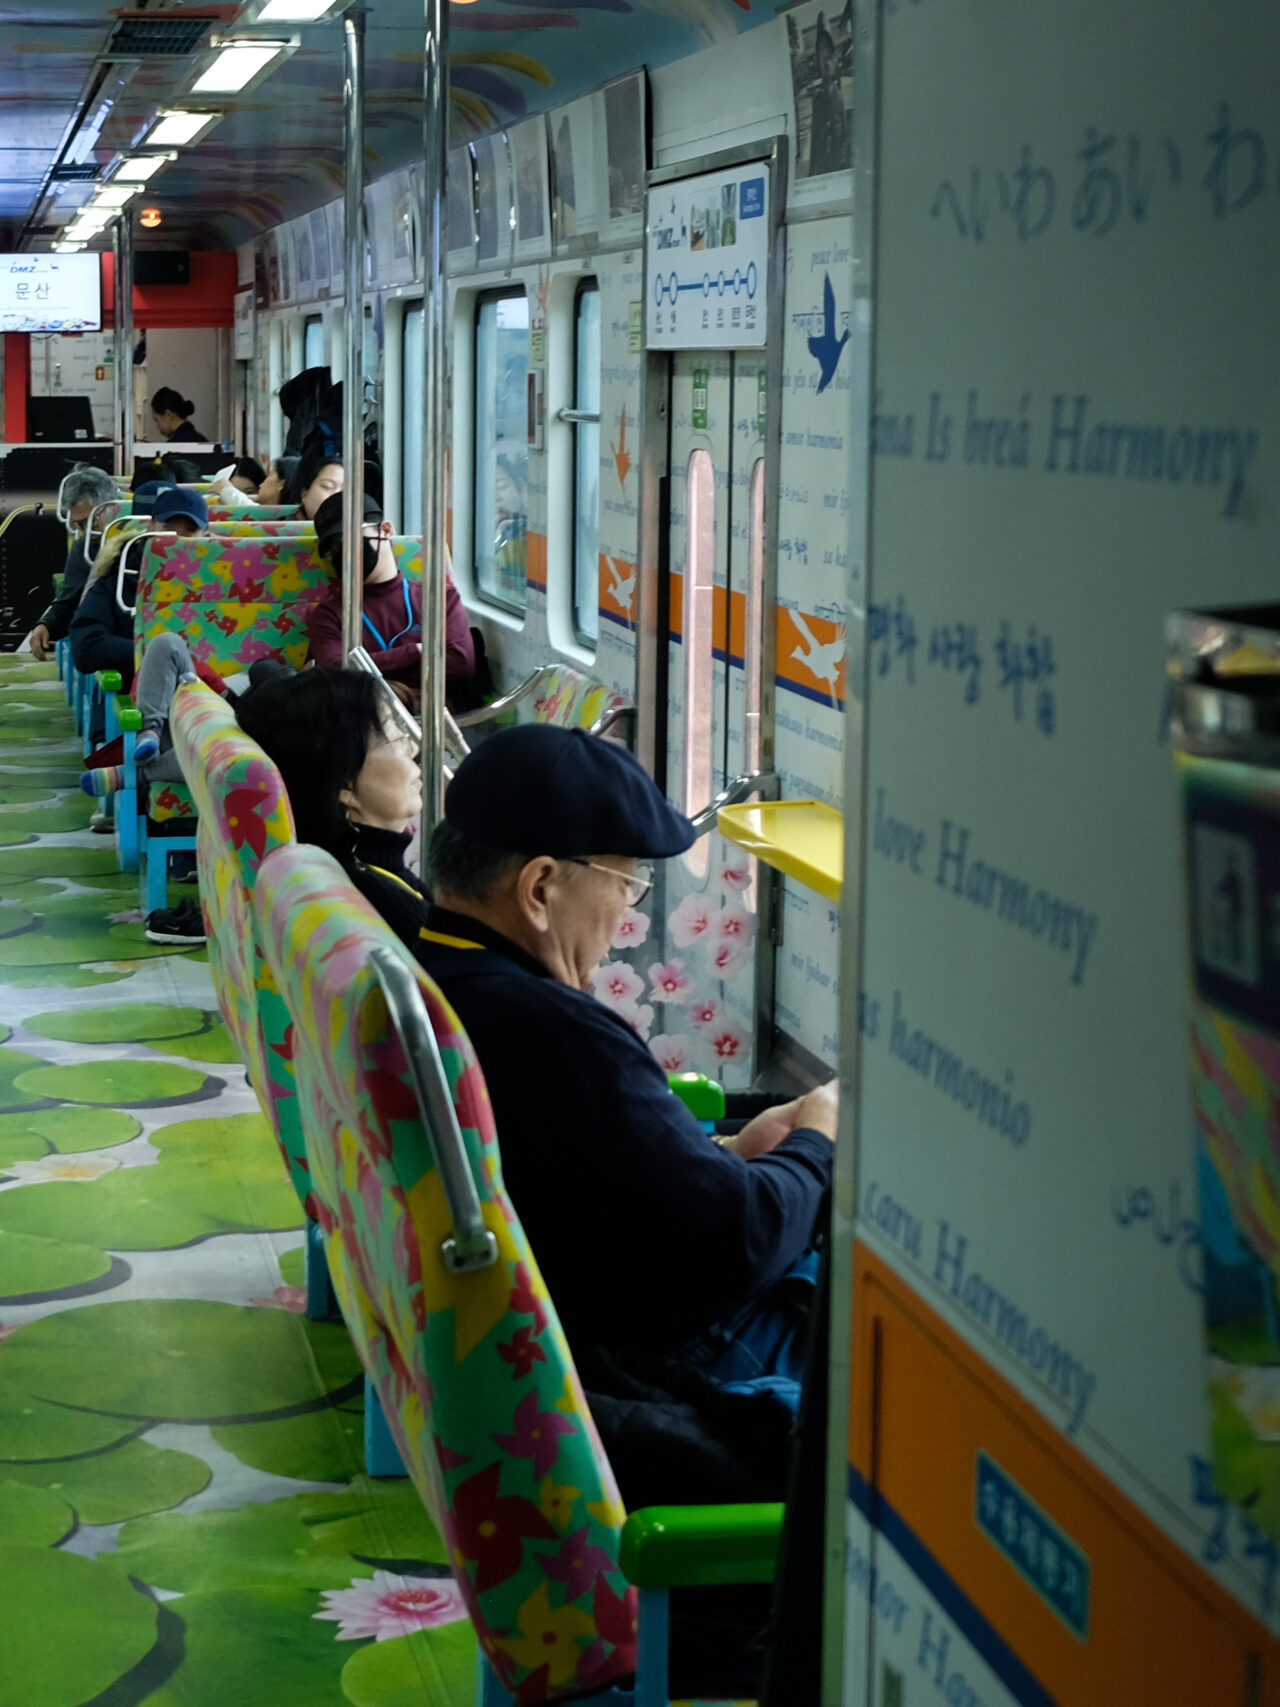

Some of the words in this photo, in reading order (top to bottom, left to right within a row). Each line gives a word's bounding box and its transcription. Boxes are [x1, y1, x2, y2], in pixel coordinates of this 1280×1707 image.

[15, 282, 50, 300] 문산
[1045, 393, 1257, 519] Harmony
[873, 786, 926, 873] love
[935, 818, 1099, 987] Harmony
[889, 990, 1031, 1147] harmonio
[933, 1220, 1096, 1438] Harmony
